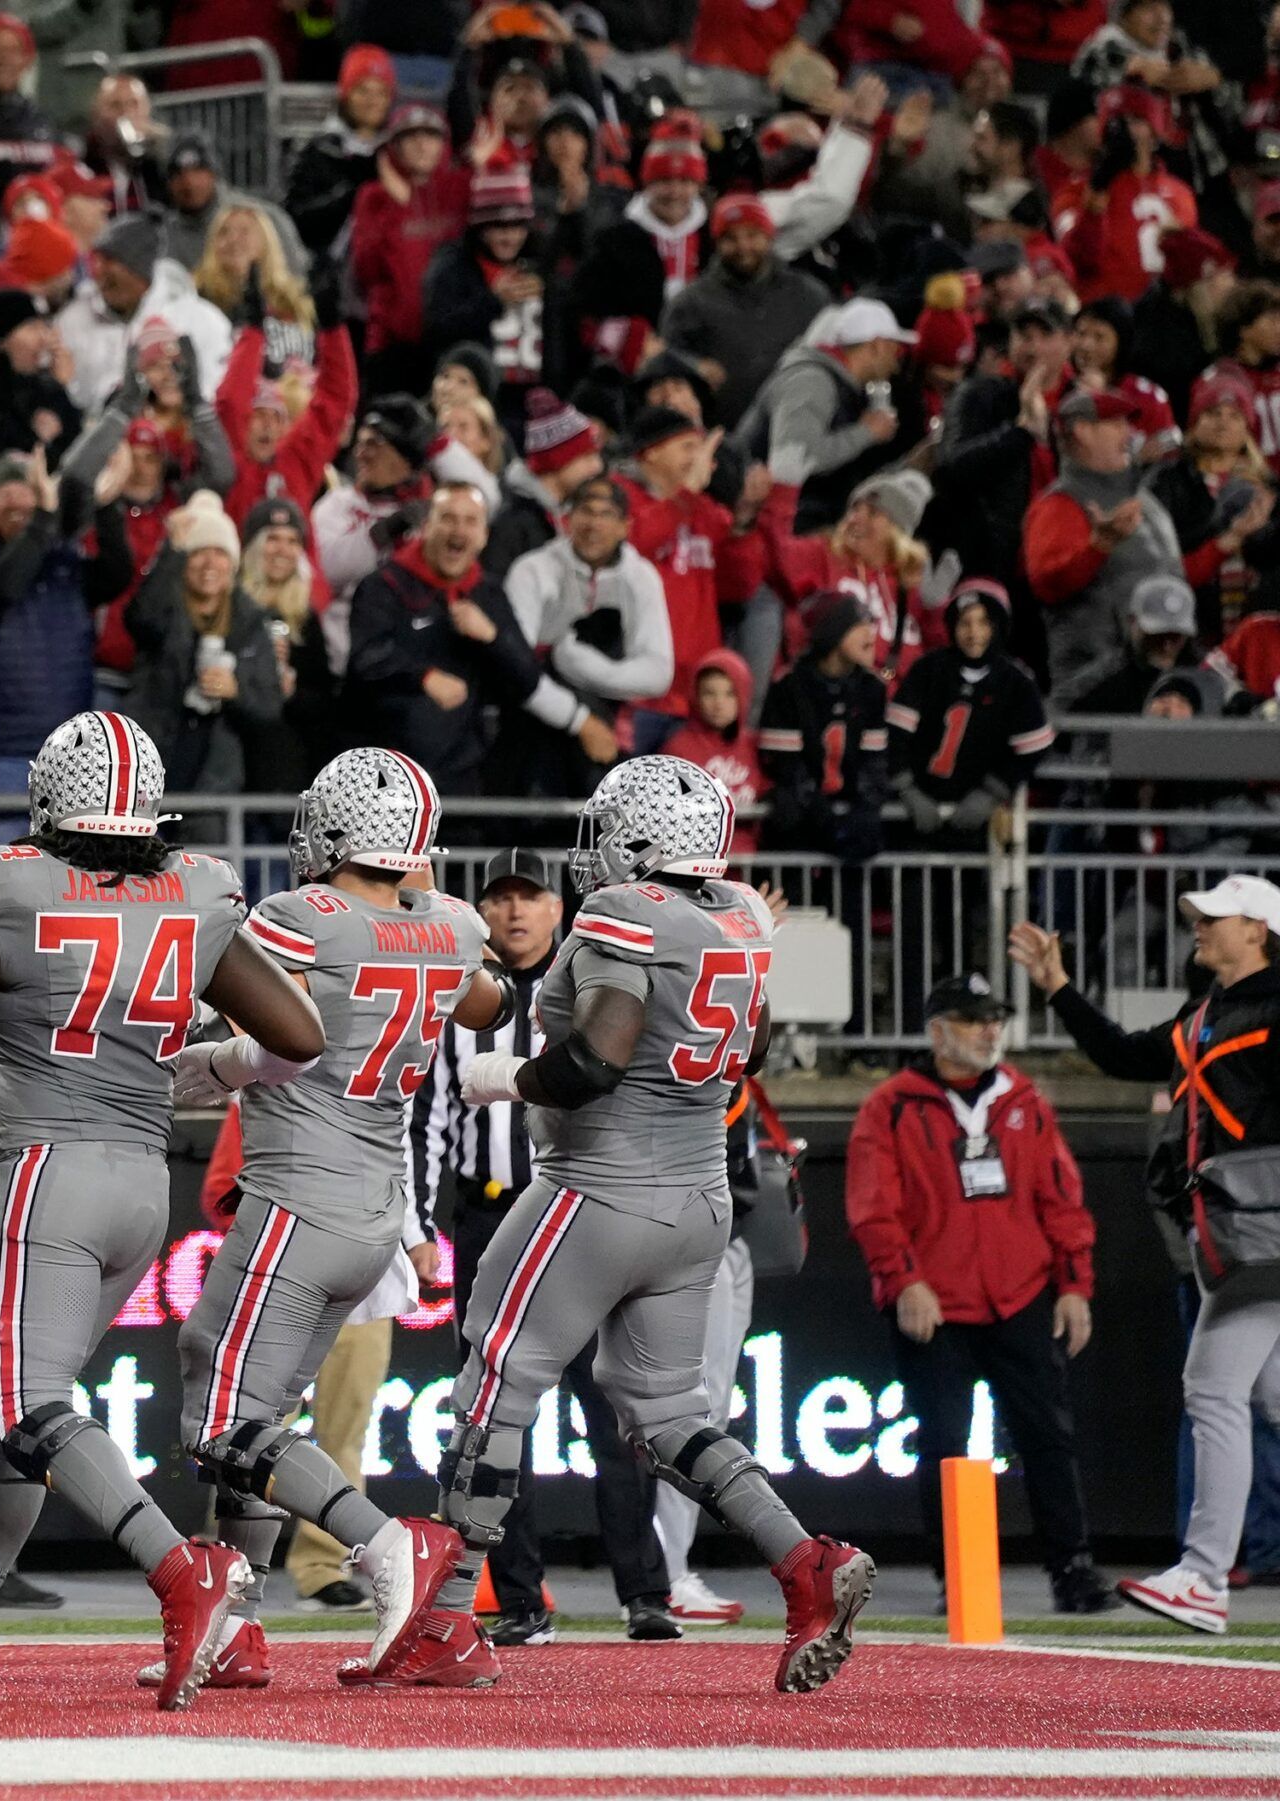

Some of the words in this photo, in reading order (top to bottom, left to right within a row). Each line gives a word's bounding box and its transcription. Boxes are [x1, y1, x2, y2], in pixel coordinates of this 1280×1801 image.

[822, 720, 847, 795] 1
[929, 703, 972, 779] 1
[76, 822, 152, 833] BUCKEYES
[62, 867, 185, 903] JACKSON
[372, 919, 457, 956] HINZMAN
[35, 911, 200, 1063] 74
[343, 962, 468, 1101] 75
